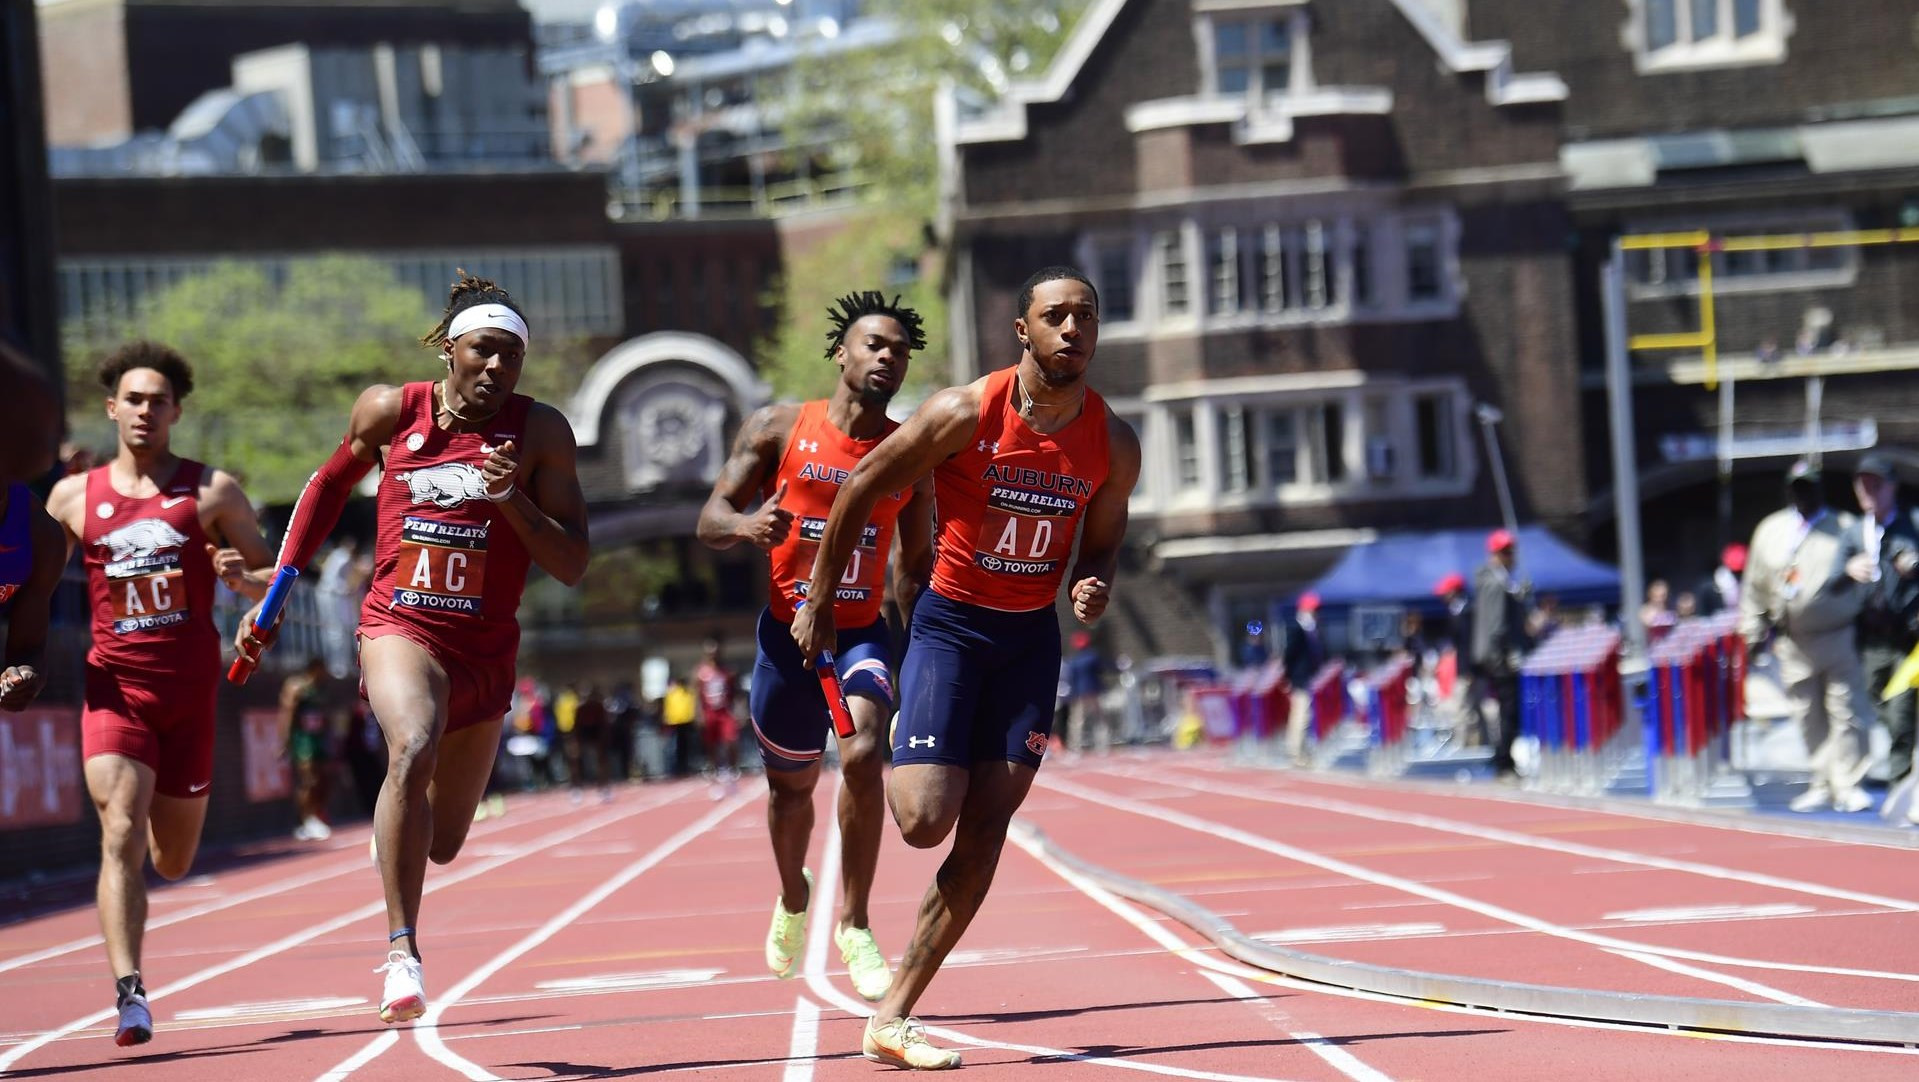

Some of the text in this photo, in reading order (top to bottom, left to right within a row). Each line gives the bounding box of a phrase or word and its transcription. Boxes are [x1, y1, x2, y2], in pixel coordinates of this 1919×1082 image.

[981, 464, 1093, 499] AUBURN
[991, 486, 1076, 510] PENN RELAYS
[403, 519, 488, 539] PENN RELAYS
[994, 516, 1052, 558] A D
[410, 548, 467, 592] A C
[1003, 562, 1050, 573] TOYOTA
[126, 575, 172, 616] A C
[421, 595, 473, 610] TOYOTA
[836, 589, 864, 600] YOTA
[139, 613, 183, 627] TOYOTA
